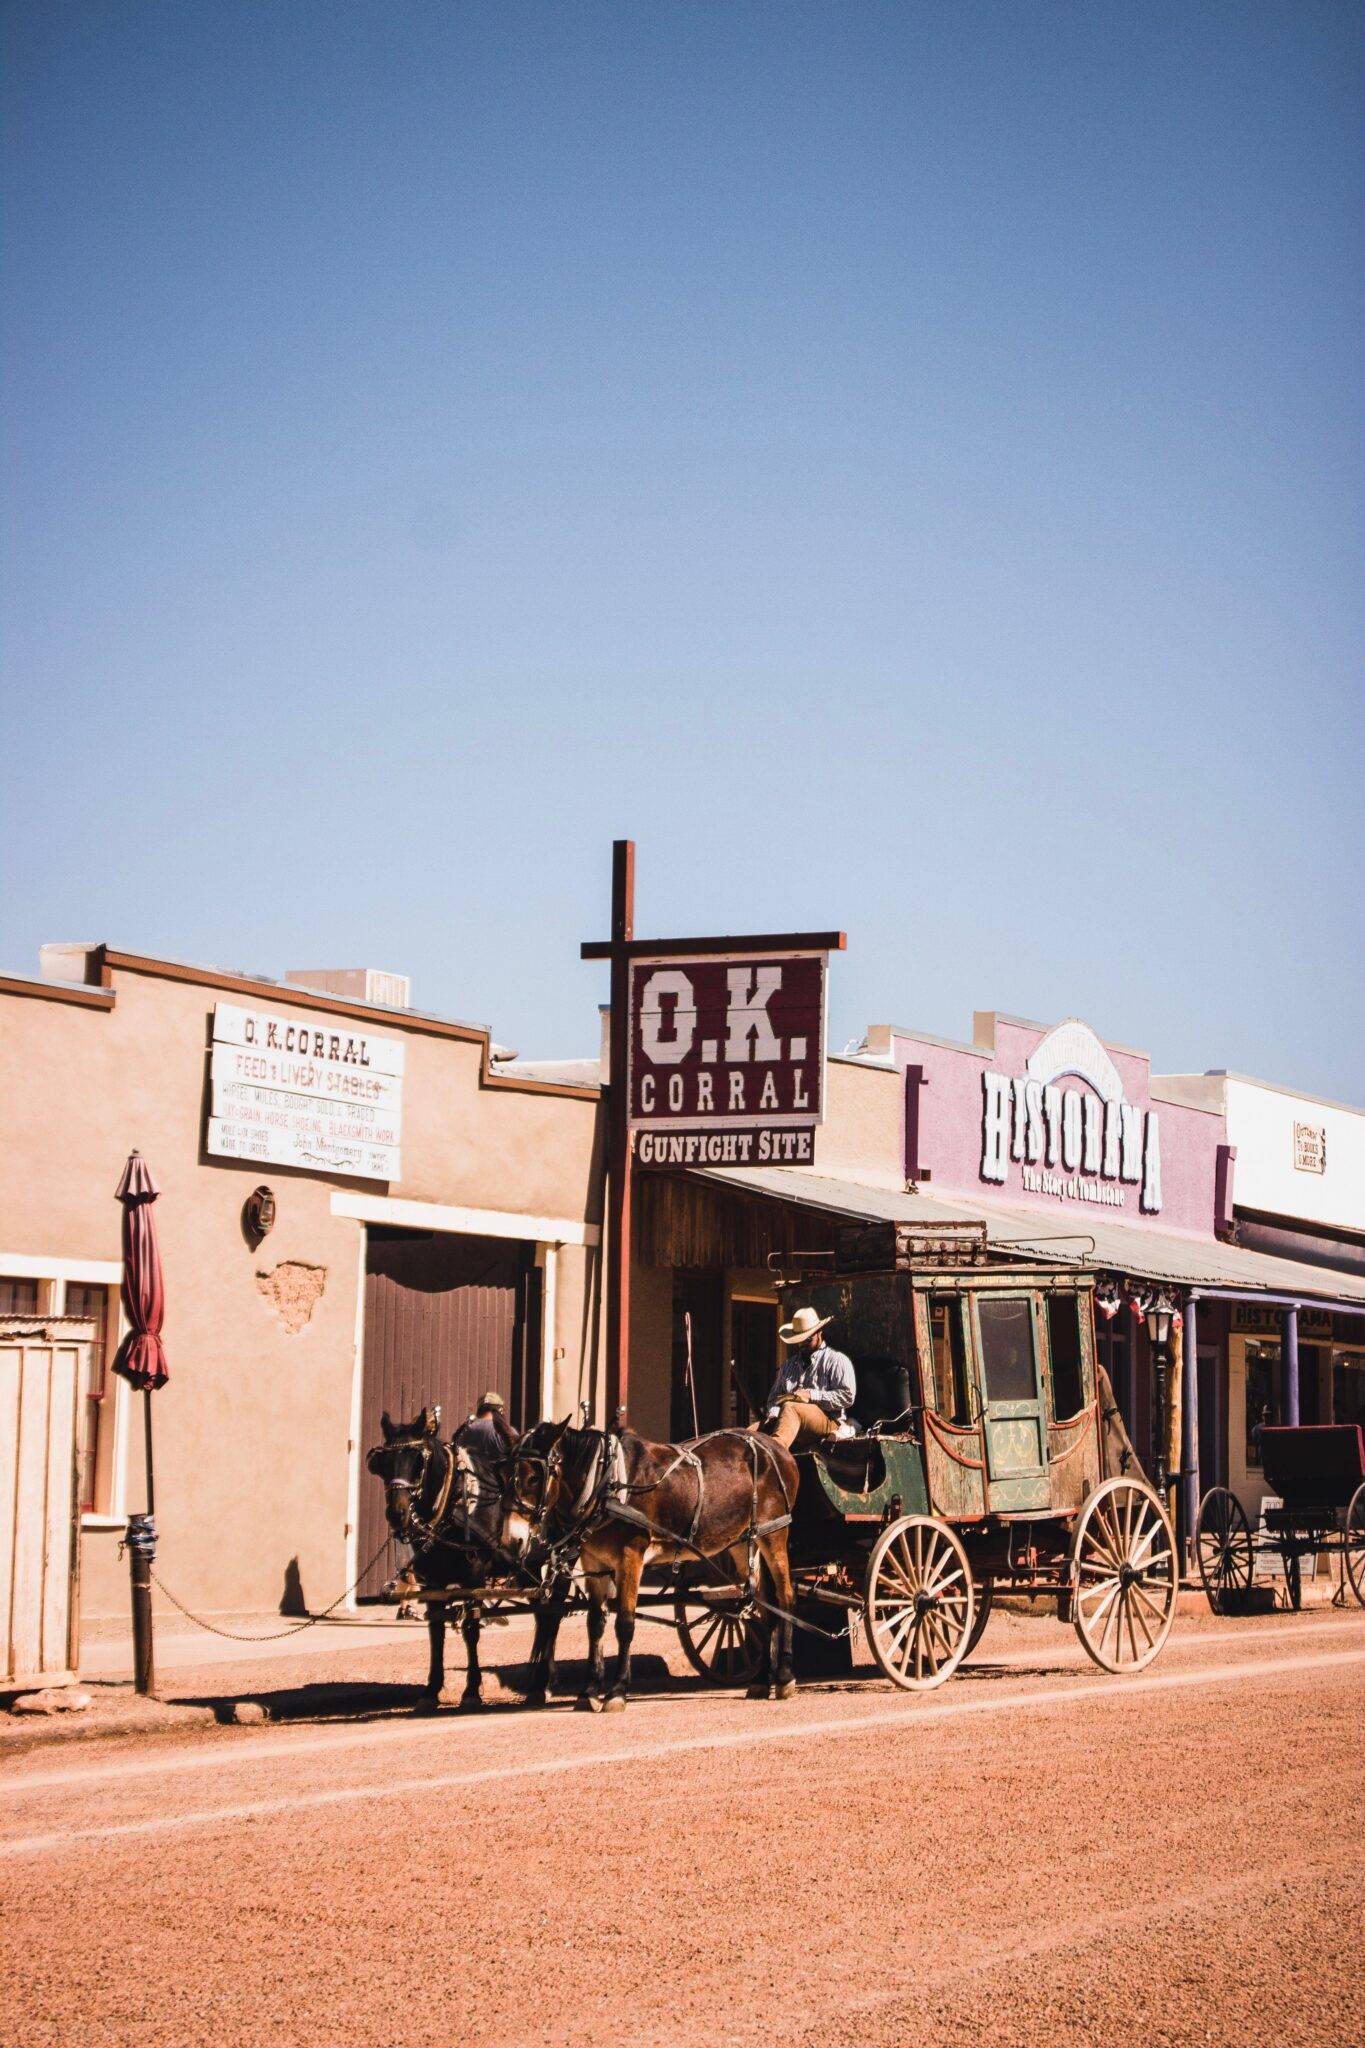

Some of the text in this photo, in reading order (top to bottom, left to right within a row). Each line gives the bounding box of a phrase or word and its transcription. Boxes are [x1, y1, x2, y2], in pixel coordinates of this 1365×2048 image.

[640, 966, 807, 1065] O.K.
[285, 1026, 371, 1066] CORRAL
[236, 1054, 267, 1079] FEED
[641, 1068, 809, 1113] CORRAL
[639, 1130, 811, 1163] GUNFIGHT SITE
[982, 1070, 1163, 1212] HISTORAMA
[1022, 1165, 1042, 1193] The
[1042, 1169, 1067, 1202] Story
[1067, 1176, 1079, 1199] of
[1237, 1307, 1331, 1327] HISTOAMA
